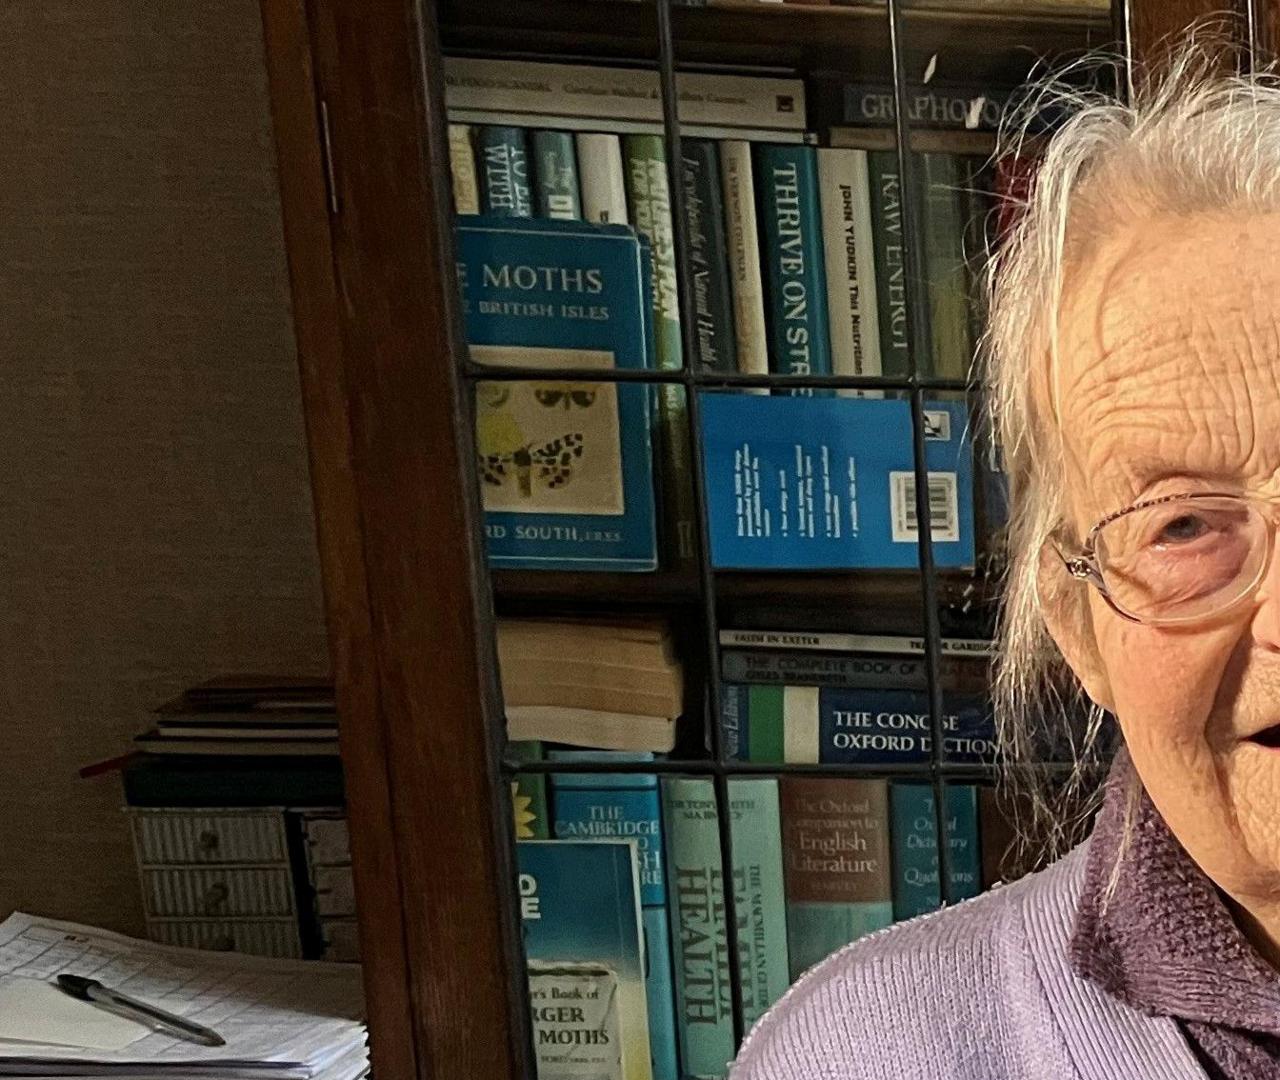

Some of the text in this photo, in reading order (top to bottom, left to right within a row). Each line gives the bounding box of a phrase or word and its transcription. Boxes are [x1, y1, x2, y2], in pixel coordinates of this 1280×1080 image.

[482, 263, 603, 294] MOTHS
[773, 162, 813, 397] THRIVE ON STRE
[478, 300, 610, 321] BRITISH ISLES
[833, 711, 959, 732] THE CONCSE
[833, 733, 914, 752] OXFORD
[588, 806, 623, 820] THE
[555, 821, 659, 836] CAMBRIDGE
[801, 831, 867, 856] English
[792, 852, 877, 873] Literature
[674, 866, 718, 1025] HEALTH
[552, 987, 582, 999] Book
[531, 1007, 585, 1022] RGER
[540, 1029, 610, 1045] MOTHS
